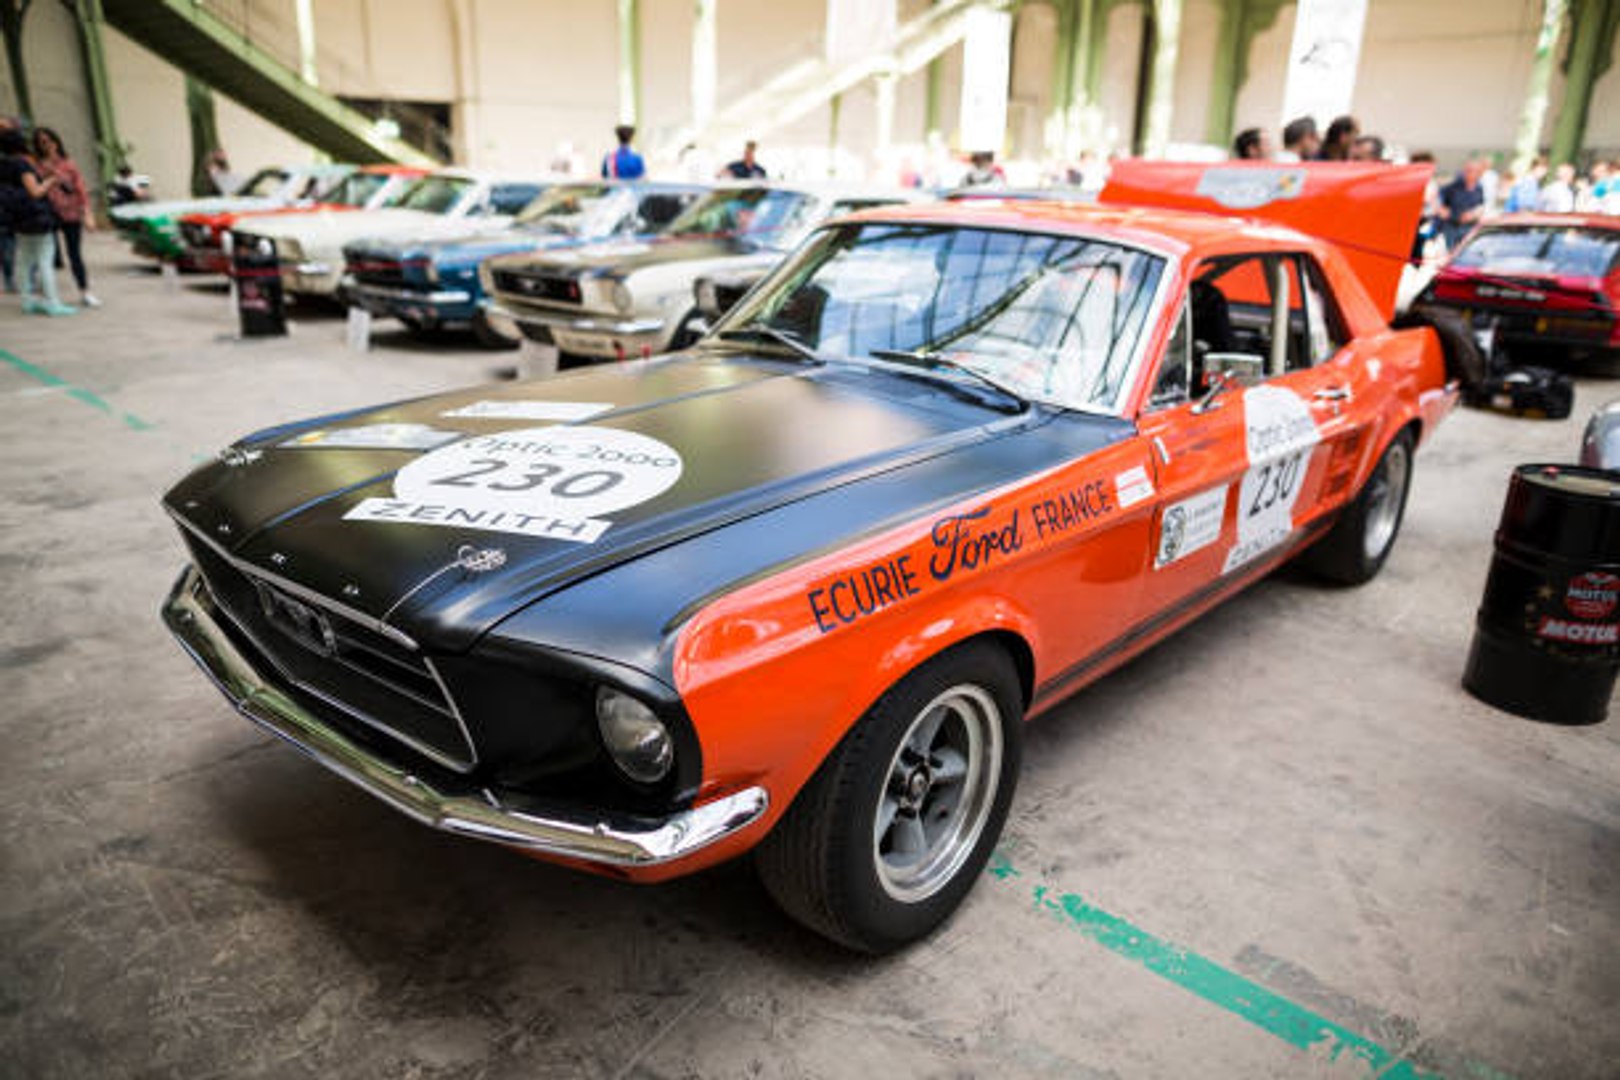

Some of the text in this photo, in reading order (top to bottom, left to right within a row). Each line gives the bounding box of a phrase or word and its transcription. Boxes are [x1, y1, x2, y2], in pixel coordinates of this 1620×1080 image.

[462, 436, 678, 468] Optic 2000
[429, 458, 625, 499] 230
[1248, 450, 1303, 519] 230
[370, 501, 590, 536] ZENITH
[807, 554, 922, 634] ECURIE
[929, 506, 1024, 581] Ford
[1031, 480, 1113, 538] FRANCE
